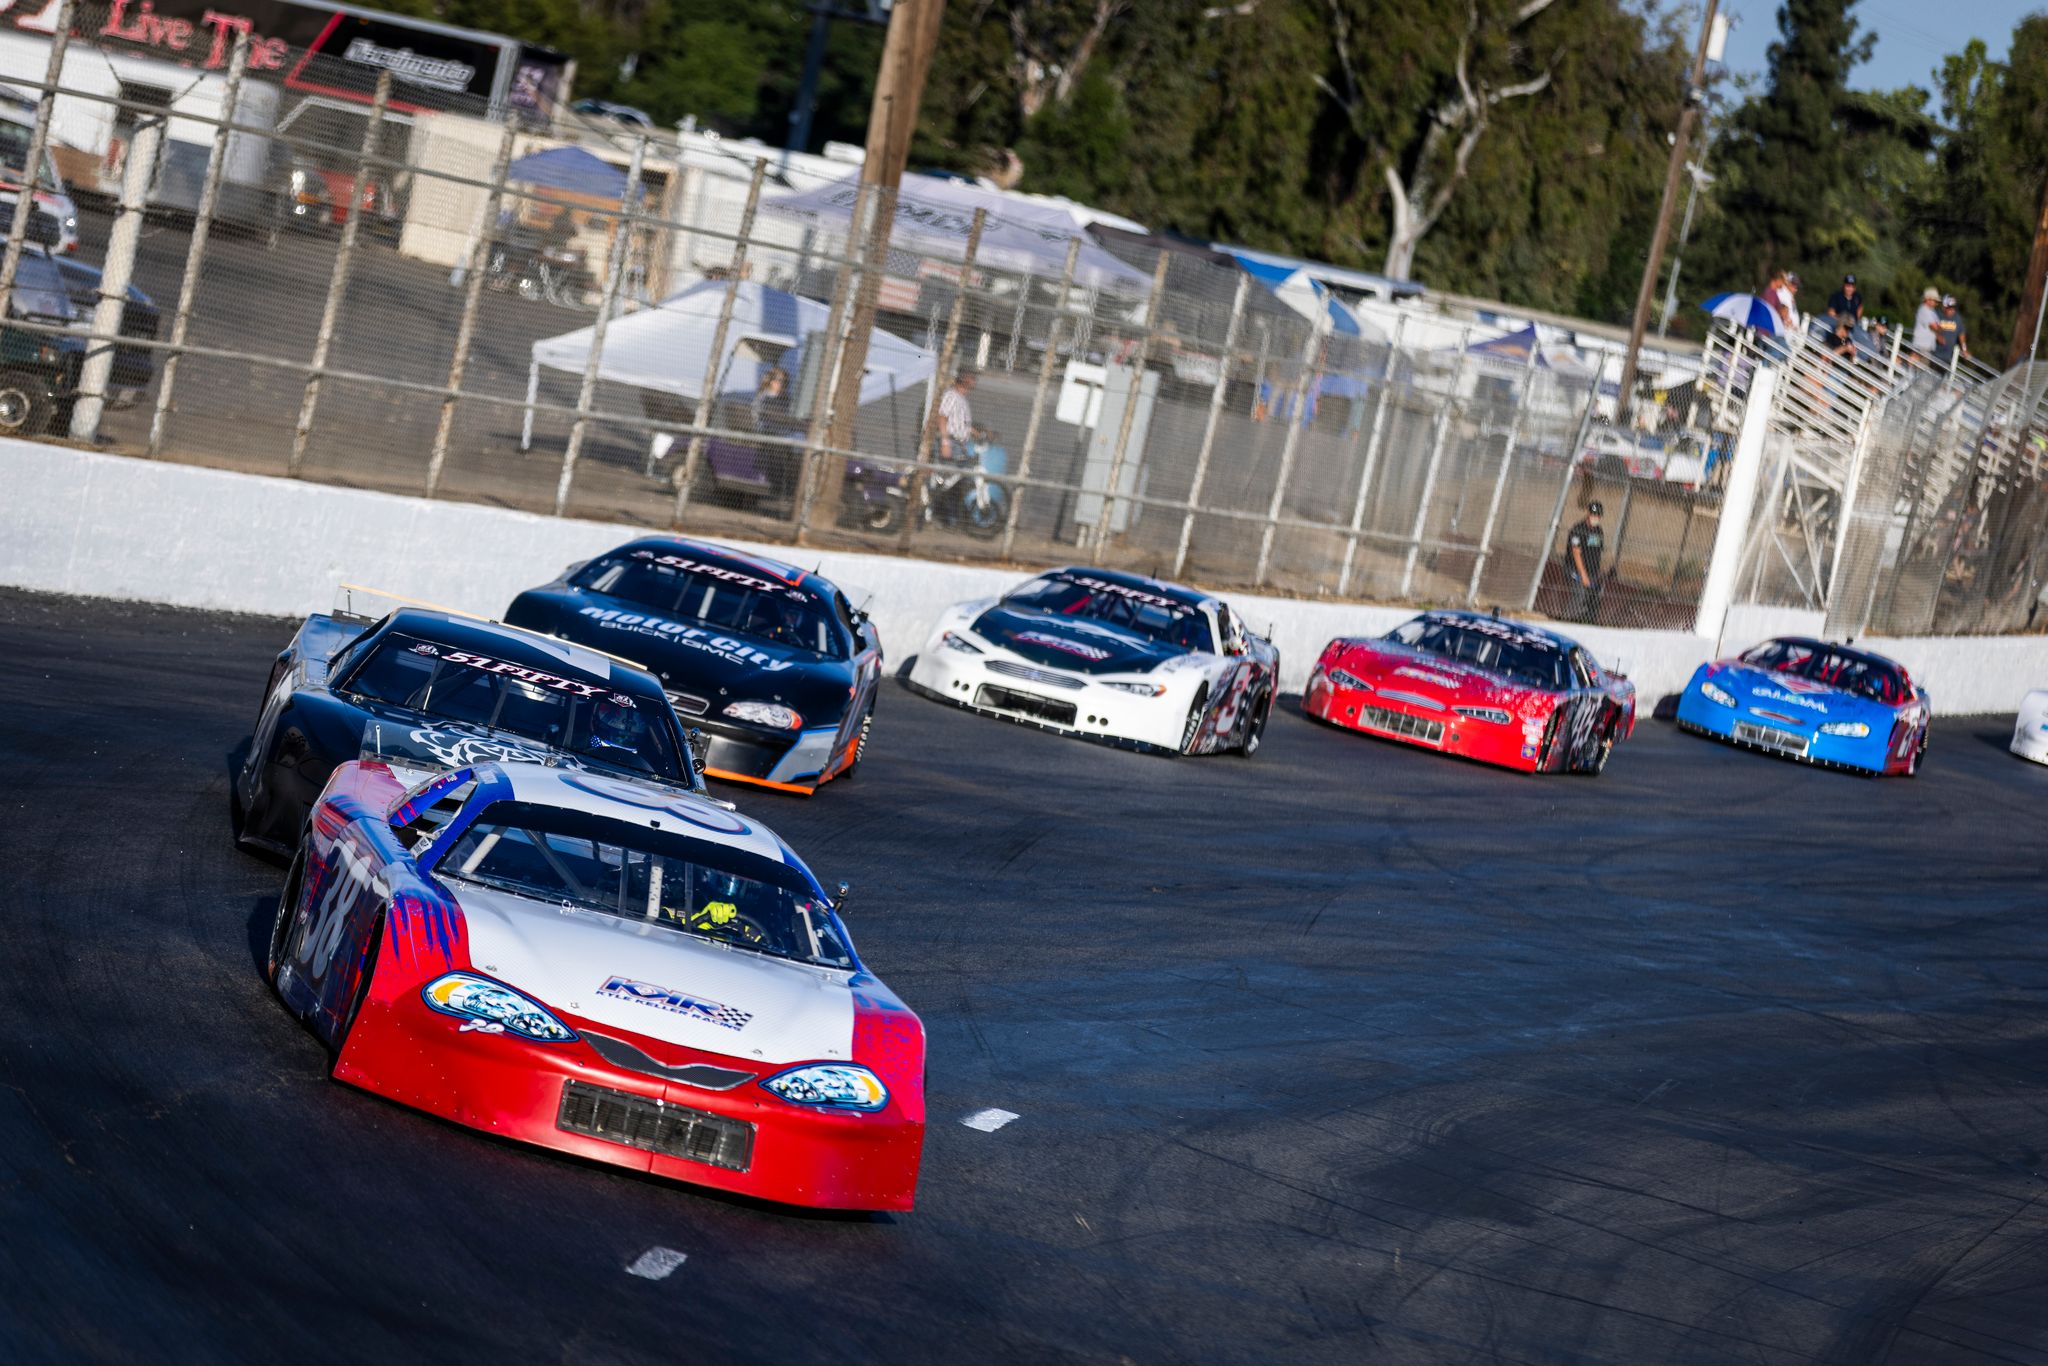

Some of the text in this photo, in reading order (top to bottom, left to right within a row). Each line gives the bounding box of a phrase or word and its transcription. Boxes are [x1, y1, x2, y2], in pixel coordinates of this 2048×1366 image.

[100, 0, 193, 49] Live
[654, 555, 786, 592] 51FIFTY
[579, 606, 794, 672] Motor City
[600, 621, 745, 665] BUICK GMC
[442, 651, 609, 697] 51FIFTY
[1215, 661, 1251, 737] 3
[299, 837, 373, 979] 38
[595, 989, 742, 1032] KYLE KELLER RACING
